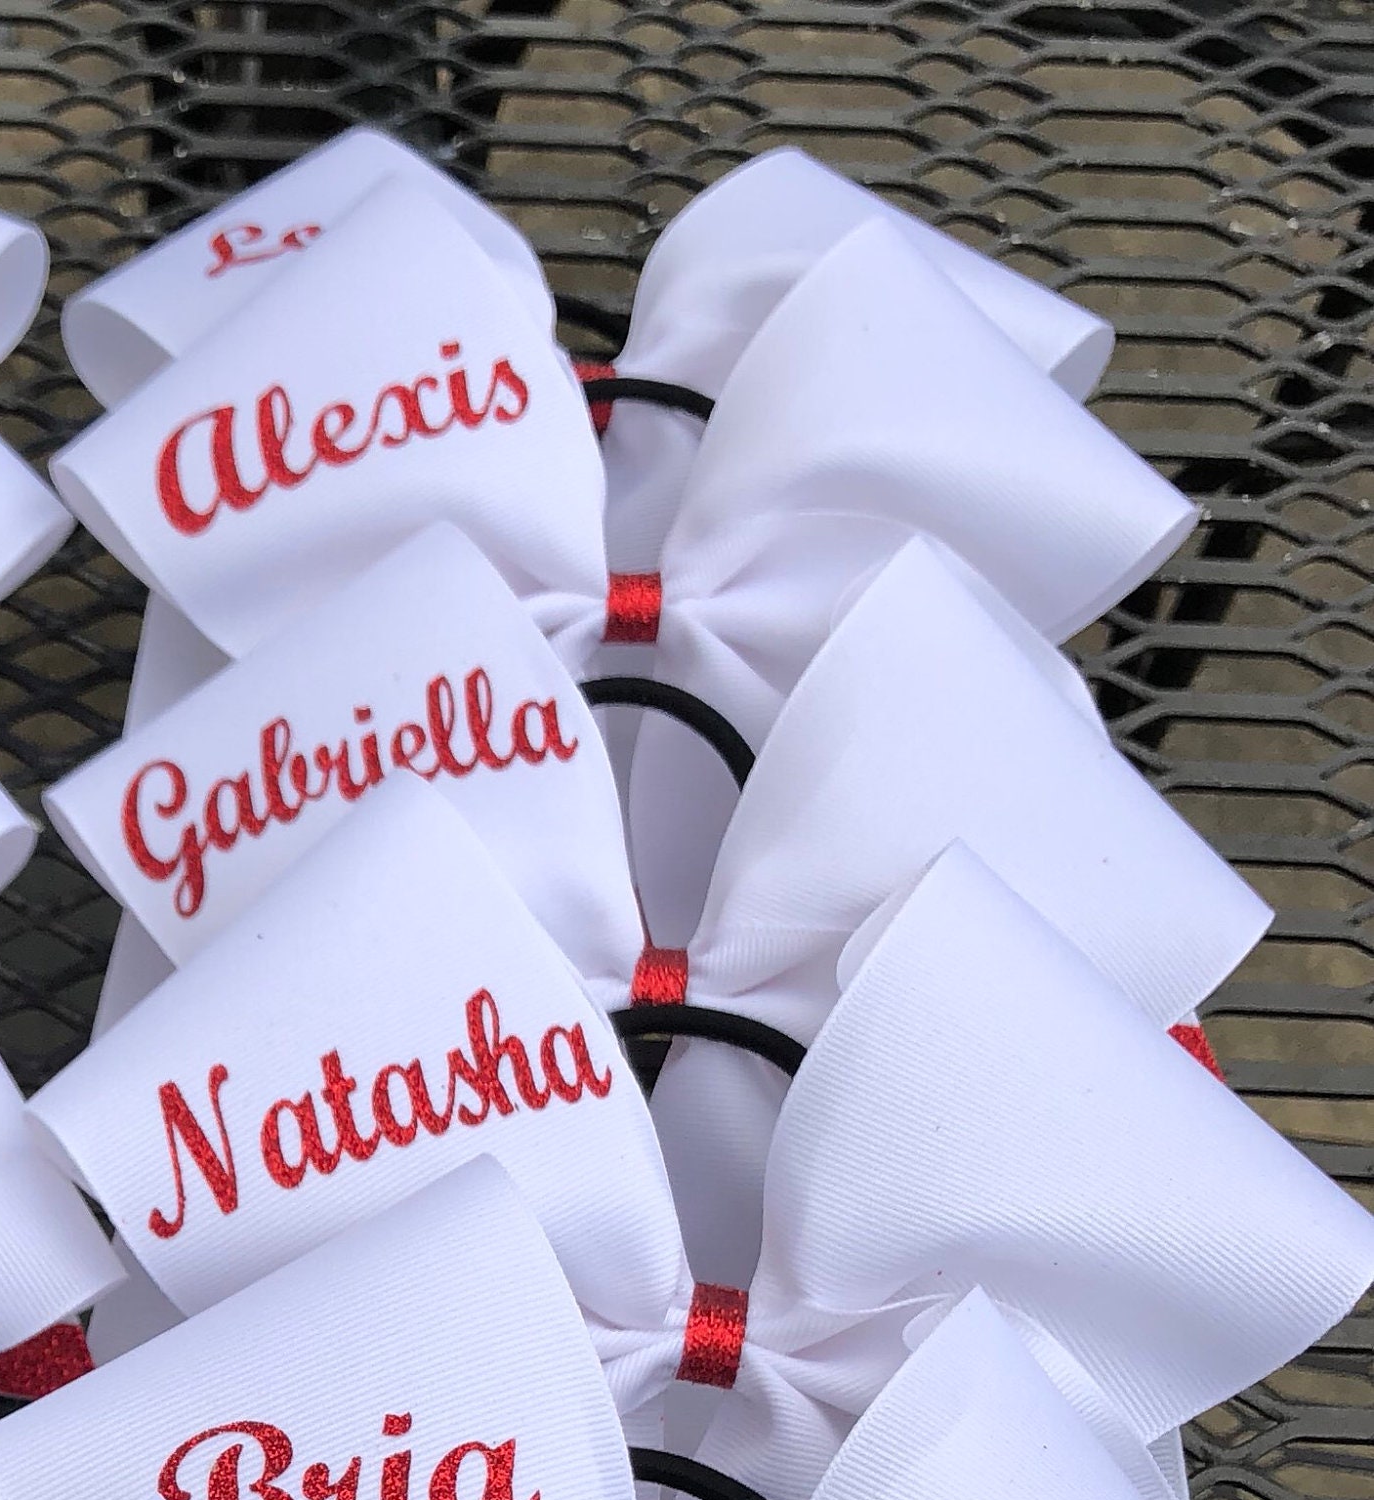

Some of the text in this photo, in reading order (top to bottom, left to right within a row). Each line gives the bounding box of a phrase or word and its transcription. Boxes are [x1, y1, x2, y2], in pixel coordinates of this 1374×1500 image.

[156, 341, 529, 536] Alexis
[121, 666, 577, 917] Gabriella
[149, 988, 612, 1238] Natasha
